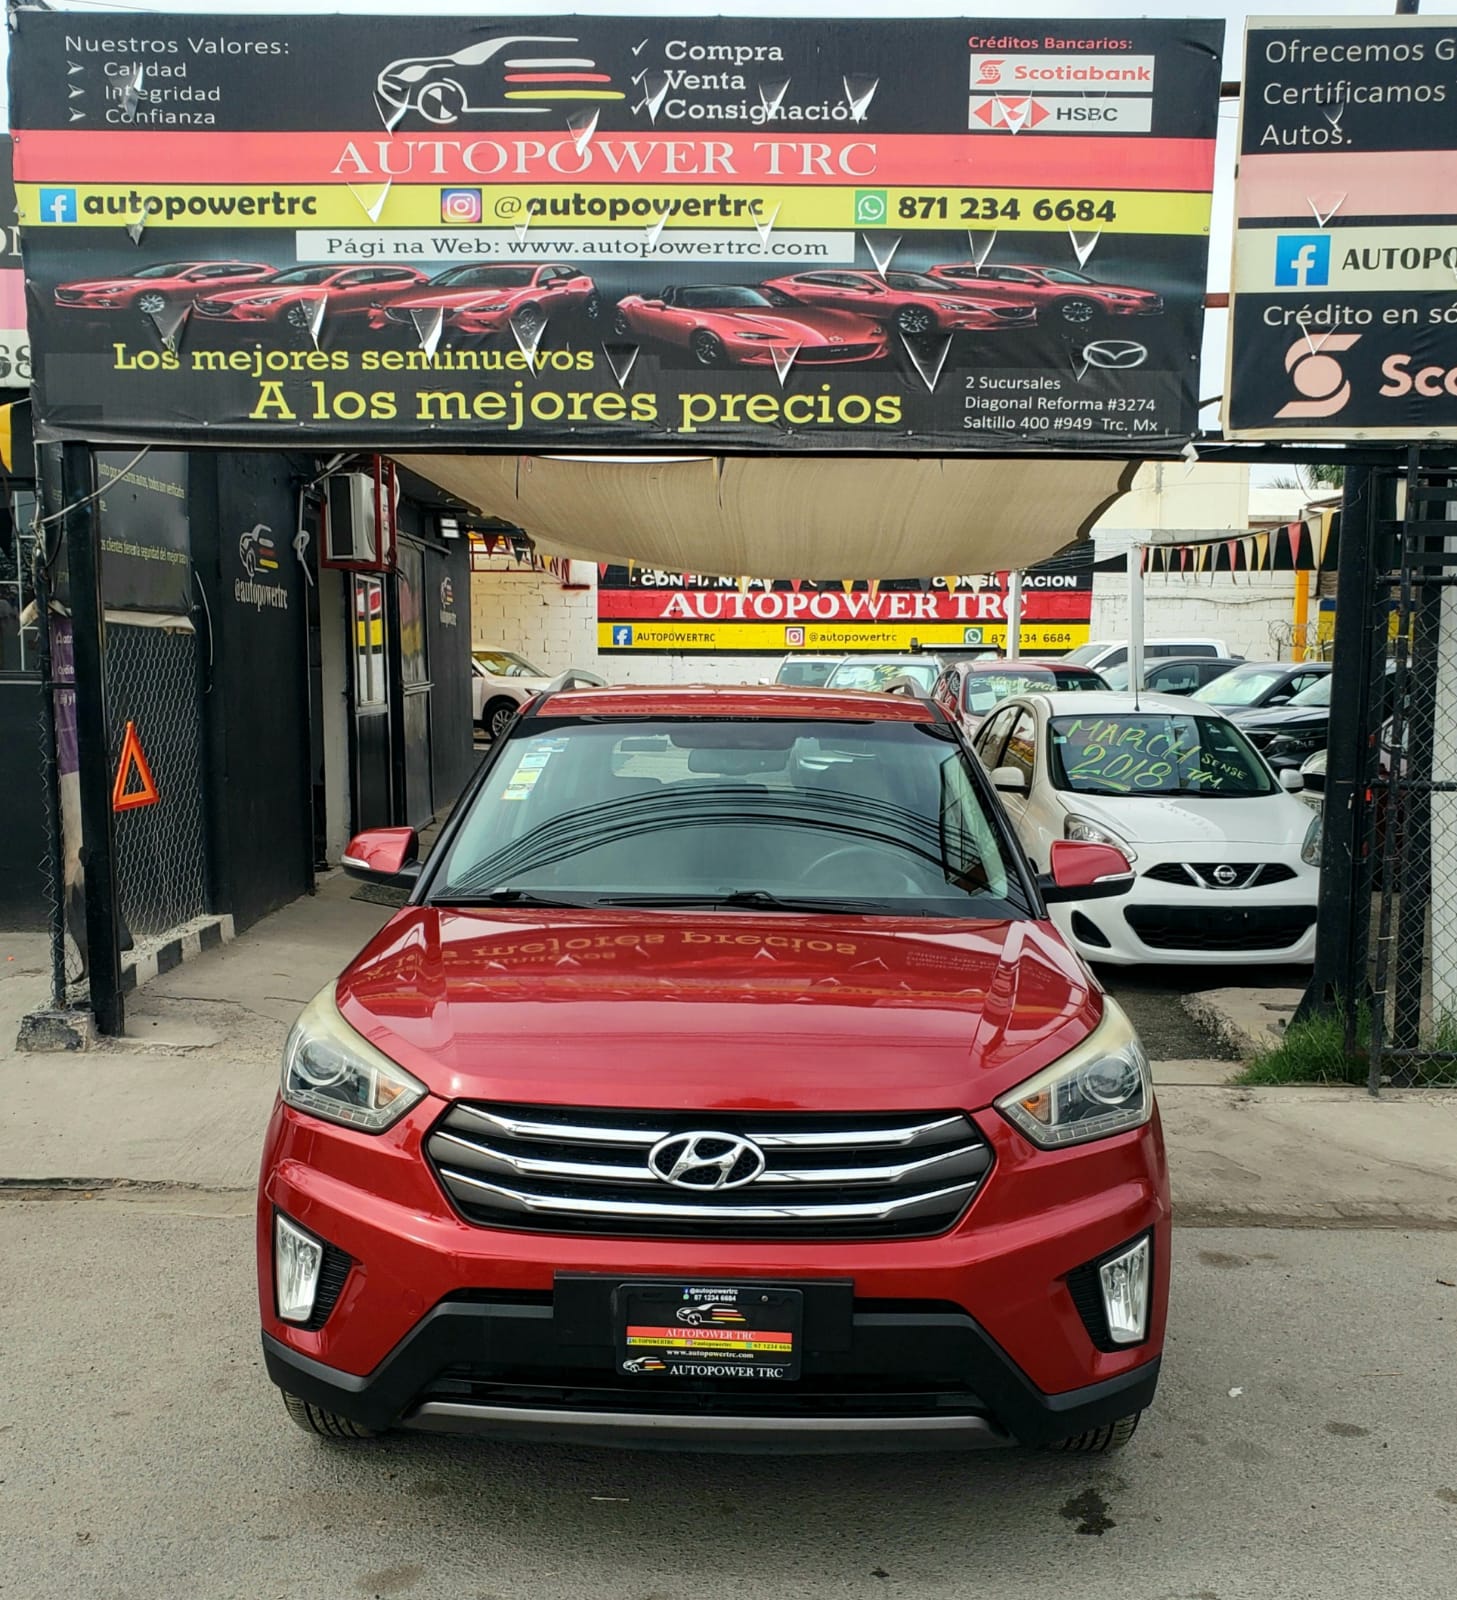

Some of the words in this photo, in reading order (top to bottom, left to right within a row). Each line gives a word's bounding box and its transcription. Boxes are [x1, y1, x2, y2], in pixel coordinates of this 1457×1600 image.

[65, 35, 179, 54] Nuestros
[188, 36, 290, 54] Valores:
[664, 40, 784, 65] Compra
[968, 36, 1039, 50] Créditos
[1043, 37, 1133, 50] Bancarios:
[1265, 39, 1424, 63] Ofrecemos
[663, 69, 746, 90] Venta
[1013, 64, 1150, 81] Scotiabank
[105, 85, 221, 104] Integridad
[1263, 80, 1446, 105] Certificamos
[105, 109, 216, 124] Confianza
[1055, 107, 1118, 121] HSBC
[1260, 124, 1353, 146] Autos.
[331, 139, 739, 176] AUTOPOWER
[753, 141, 878, 177] TRC
[83, 190, 317, 220] autopowertrc
[494, 193, 763, 221] @autopowertrc
[898, 196, 948, 219] 871
[960, 198, 1021, 220] 234
[1032, 199, 1116, 222] 6684
[431, 238, 499, 254] Web:
[508, 239, 829, 259] www.autopowertrc.com
[1263, 304, 1373, 326] Crédito
[1382, 307, 1418, 325] en
[112, 343, 180, 370] Los
[191, 343, 350, 378] mejores
[361, 343, 595, 371] seminuevos
[965, 376, 975, 389] 2
[979, 376, 1061, 390] Sucursales
[248, 380, 297, 420] A
[311, 380, 398, 420] los
[415, 380, 658, 431] mejores
[677, 383, 903, 433] precios
[965, 396, 1033, 412] Diagonal
[1037, 396, 1103, 411] Reforma
[1107, 398, 1156, 412] #3274
[963, 415, 1016, 430] Saltillo
[1019, 415, 1050, 430] 400
[1053, 416, 1093, 431] #949
[1101, 418, 1128, 431] Trc.
[1133, 418, 1158, 432] Mx
[234, 577, 288, 612] @autopowertrc
[658, 592, 940, 619] AUTOPOWER
[636, 631, 716, 643] AUTOPOWERTRC
[1042, 632, 1072, 643] 6684
[1066, 719, 1202, 764] MARCH
[1066, 744, 1173, 789] 2018
[1200, 752, 1248, 781] SENSE
[665, 1327, 733, 1340] AUTOPOWER
[735, 1330, 756, 1341] TRC
[670, 1364, 754, 1377] AUTOPOWER
[757, 1366, 784, 1378] TRC
